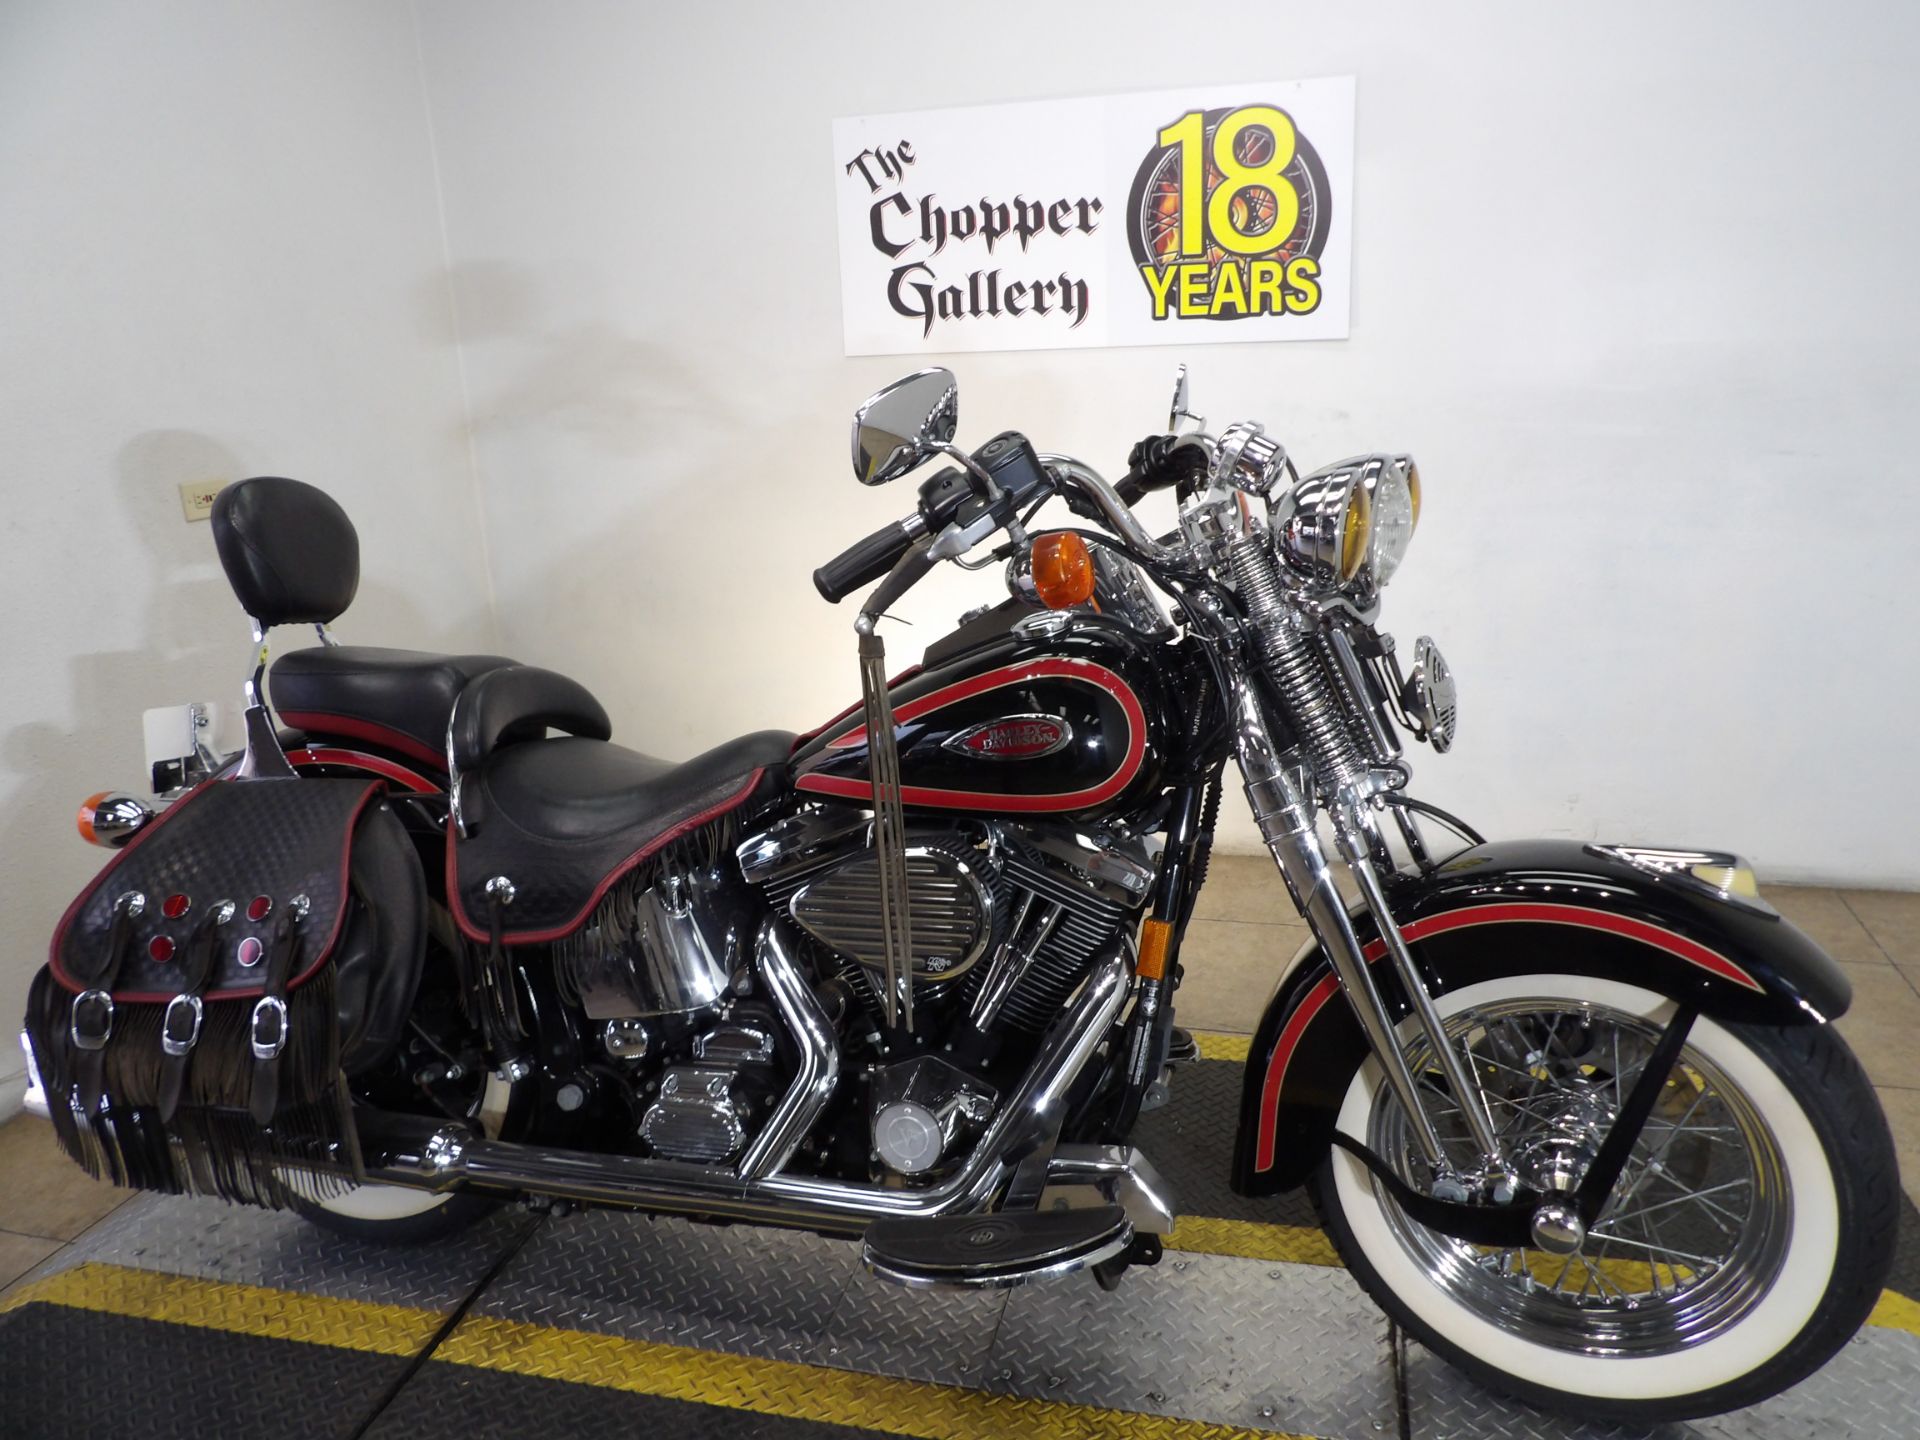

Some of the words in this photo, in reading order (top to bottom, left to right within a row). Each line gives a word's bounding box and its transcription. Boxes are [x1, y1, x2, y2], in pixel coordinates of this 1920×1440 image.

[846, 138, 917, 194] The
[1156, 103, 1300, 257] 18
[869, 191, 1103, 260] Chopper
[887, 260, 1090, 340] Gallery
[1140, 257, 1322, 320] YEARS
